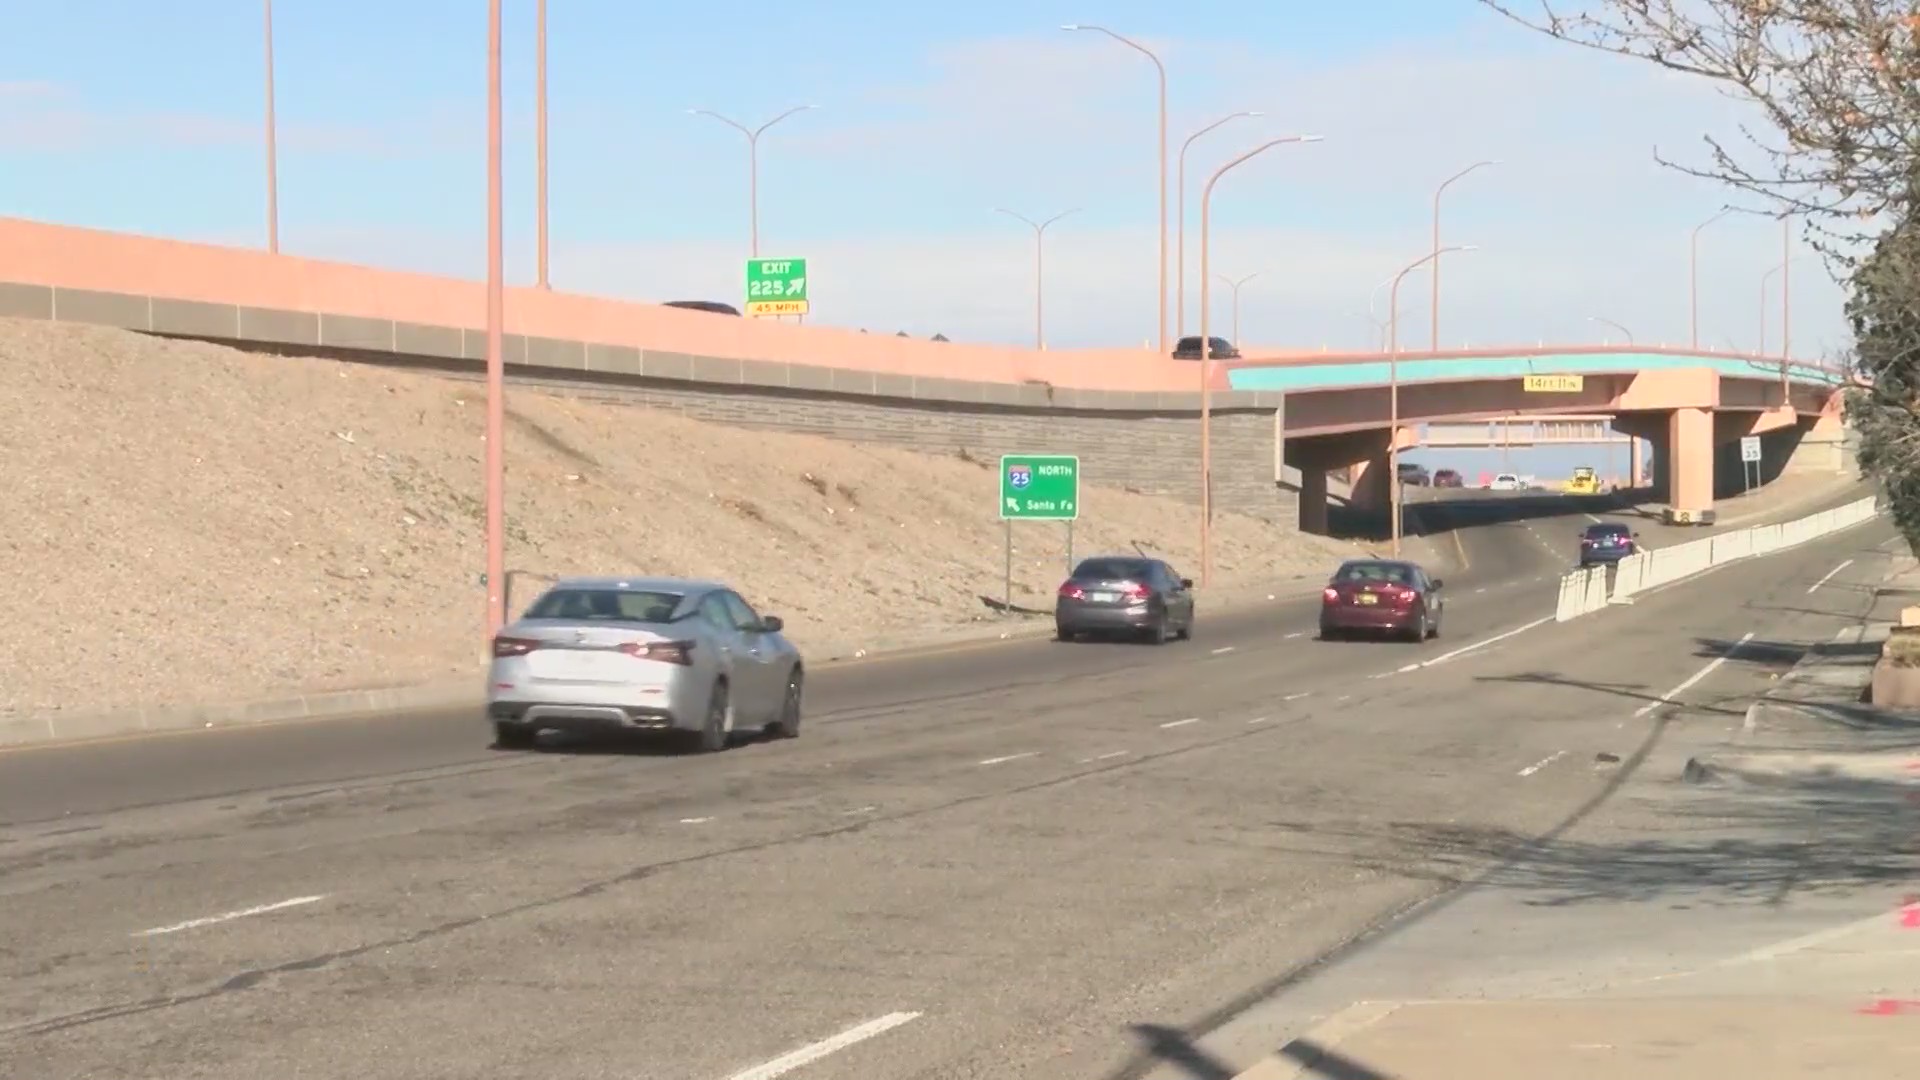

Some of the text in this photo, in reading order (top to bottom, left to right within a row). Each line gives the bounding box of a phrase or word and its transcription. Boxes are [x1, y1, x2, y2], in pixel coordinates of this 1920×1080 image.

[762, 262, 791, 274] EXIT
[750, 280, 784, 295] 225
[756, 304, 799, 312] 45 MPH
[1038, 465, 1072, 475] NORTH
[1012, 472, 1029, 484] 25
[1027, 500, 1073, 510] Santa Fe
